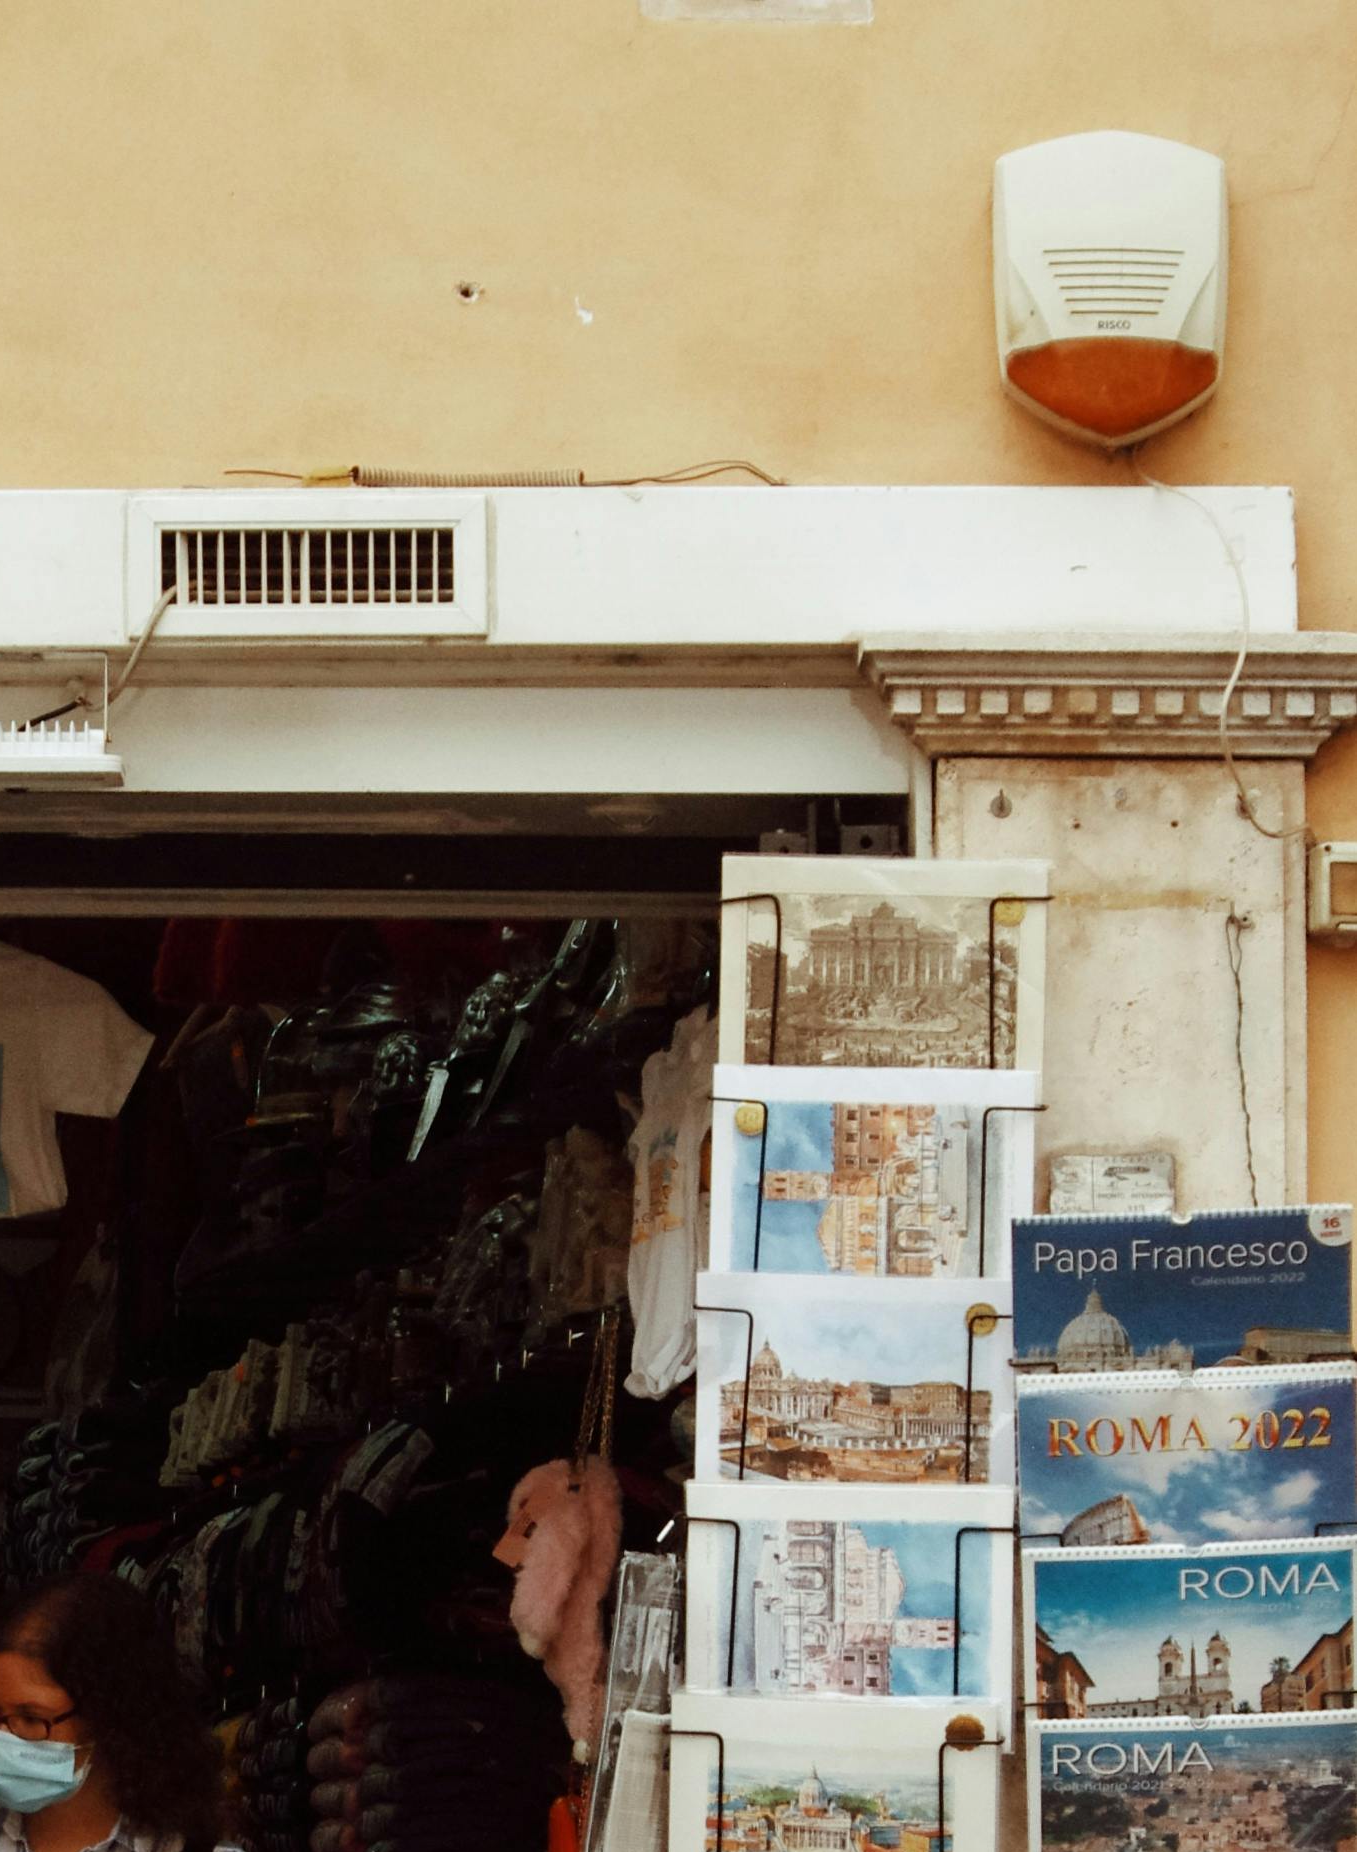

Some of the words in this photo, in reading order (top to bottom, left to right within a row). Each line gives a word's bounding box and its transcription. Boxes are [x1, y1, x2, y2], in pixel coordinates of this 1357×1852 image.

[1097, 320, 1131, 331] RISCO
[1321, 1216, 1341, 1230] 16
[1033, 1241, 1119, 1280] Papa
[1130, 1239, 1310, 1272] Francesco
[1269, 1271, 1307, 1284] 2022
[1047, 1412, 1215, 1459] ROMA
[1228, 1406, 1333, 1452] 2022
[1179, 1562, 1342, 1601] ROMA
[1052, 1741, 1215, 1776] ROMA
[1053, 1779, 1128, 1793] Calendario
[1131, 1778, 1163, 1791] 2021
